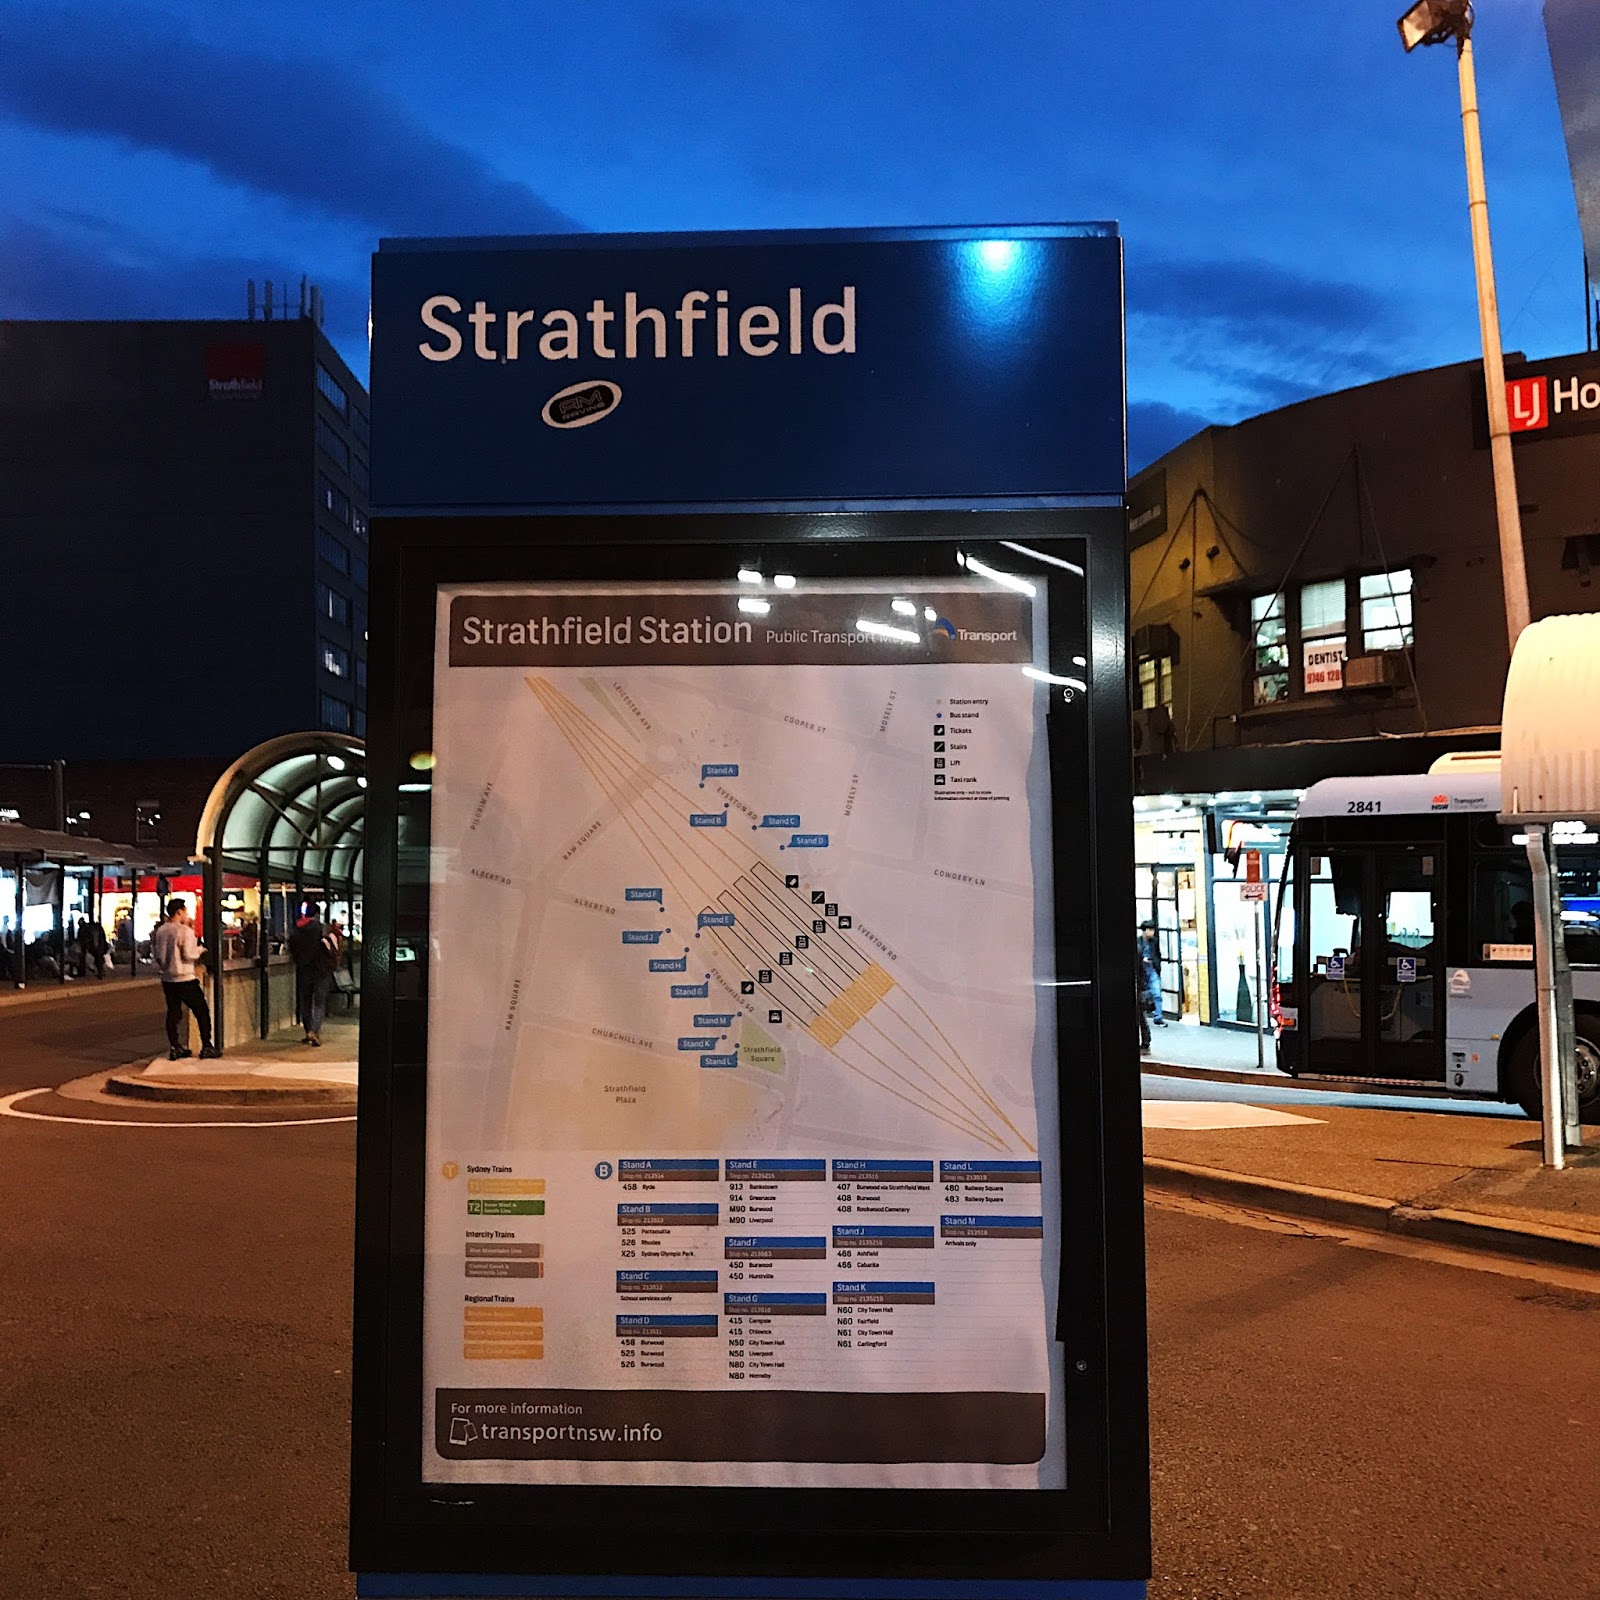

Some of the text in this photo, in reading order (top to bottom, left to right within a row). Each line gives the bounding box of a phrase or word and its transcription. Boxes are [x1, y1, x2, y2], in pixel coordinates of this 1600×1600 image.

[419, 286, 856, 363] Strathfield
[1513, 382, 1541, 427] LJ
[463, 616, 631, 645] Strathfield
[638, 616, 752, 644] Station
[766, 630, 808, 643] Public
[957, 628, 1017, 642] Transport
[1308, 650, 1343, 666] DENTIST
[1327, 669, 1342, 681] 128
[613, 682, 652, 731] LEICESTER AVE
[880, 690, 897, 732] MOSELY ST
[784, 715, 826, 734] COOPER ST
[706, 766, 734, 775] Stand A
[845, 774, 859, 817] MOSELY ST
[471, 782, 494, 831] PILGRIM AVE
[716, 786, 758, 821] EVERTON RD
[1347, 801, 1382, 813] 2841
[694, 816, 722, 825] Stand B
[768, 817, 796, 825] Stand C
[563, 820, 602, 861] RAW SQUARE
[796, 836, 824, 845] Stand D
[471, 868, 498, 882] ALBERT
[934, 869, 986, 886] COWDERY LN
[1241, 884, 1265, 893] POLICE
[630, 890, 657, 898] Stand F
[574, 897, 603, 912] ALBERT
[703, 916, 730, 924] Stand E
[627, 933, 654, 941] Stand J
[857, 924, 898, 962] EVERTON RD
[653, 962, 682, 970] Stand H
[675, 988, 703, 996] Stand G
[710, 967, 755, 1013] STRATHFIELD SQ
[505, 979, 522, 1031] RAW SQUARE
[697, 1017, 727, 1025] Stand M
[591, 1027, 653, 1049] CHURCHILL AVE
[683, 1040, 710, 1048] Stand K
[705, 1057, 732, 1065] Stand L
[751, 1055, 775, 1063] Square
[604, 1085, 646, 1093] Strathfield
[615, 1096, 637, 1104] Plaza
[622, 1161, 652, 1169] Stand A
[729, 1161, 758, 1169] Stand E
[836, 1161, 866, 1169] Stand H
[944, 1162, 973, 1170] Stand L
[467, 1165, 512, 1174] Sydney Trains
[599, 1165, 609, 1177] B
[622, 1183, 637, 1191] 458
[729, 1183, 743, 1191] 913
[836, 1183, 851, 1191] 407
[944, 1184, 960, 1192] 480
[729, 1194, 743, 1202] 914
[836, 1194, 852, 1202] 408
[944, 1195, 960, 1203] 483
[468, 1202, 480, 1212] T2
[621, 1205, 651, 1213] Stand B
[729, 1205, 746, 1213] M90
[836, 1205, 852, 1213] 408
[729, 1216, 746, 1224] M90
[944, 1217, 976, 1225] Stand M
[465, 1230, 494, 1239] Intercity
[836, 1227, 865, 1235] Stand J
[729, 1238, 757, 1247] Stand F
[728, 1261, 744, 1269] 450
[620, 1271, 650, 1280] Stand C
[728, 1272, 744, 1280] 450
[836, 1283, 867, 1292] Stand K
[464, 1294, 515, 1304] Regional Trains
[728, 1294, 758, 1303] Stand G
[837, 1306, 853, 1314] N60
[620, 1316, 650, 1324] Stand D
[728, 1317, 743, 1325] 415
[837, 1317, 853, 1326] N60
[728, 1328, 743, 1336] 415
[837, 1329, 852, 1337] N61
[620, 1338, 636, 1346] 458
[728, 1339, 745, 1347] N50
[837, 1340, 852, 1348] N61
[620, 1349, 636, 1357] 525
[620, 1360, 636, 1368] 526
[728, 1361, 745, 1369] N80
[728, 1372, 745, 1380] N80
[451, 1402, 583, 1415] For more information
[481, 1422, 663, 1444] transportnsw.info
